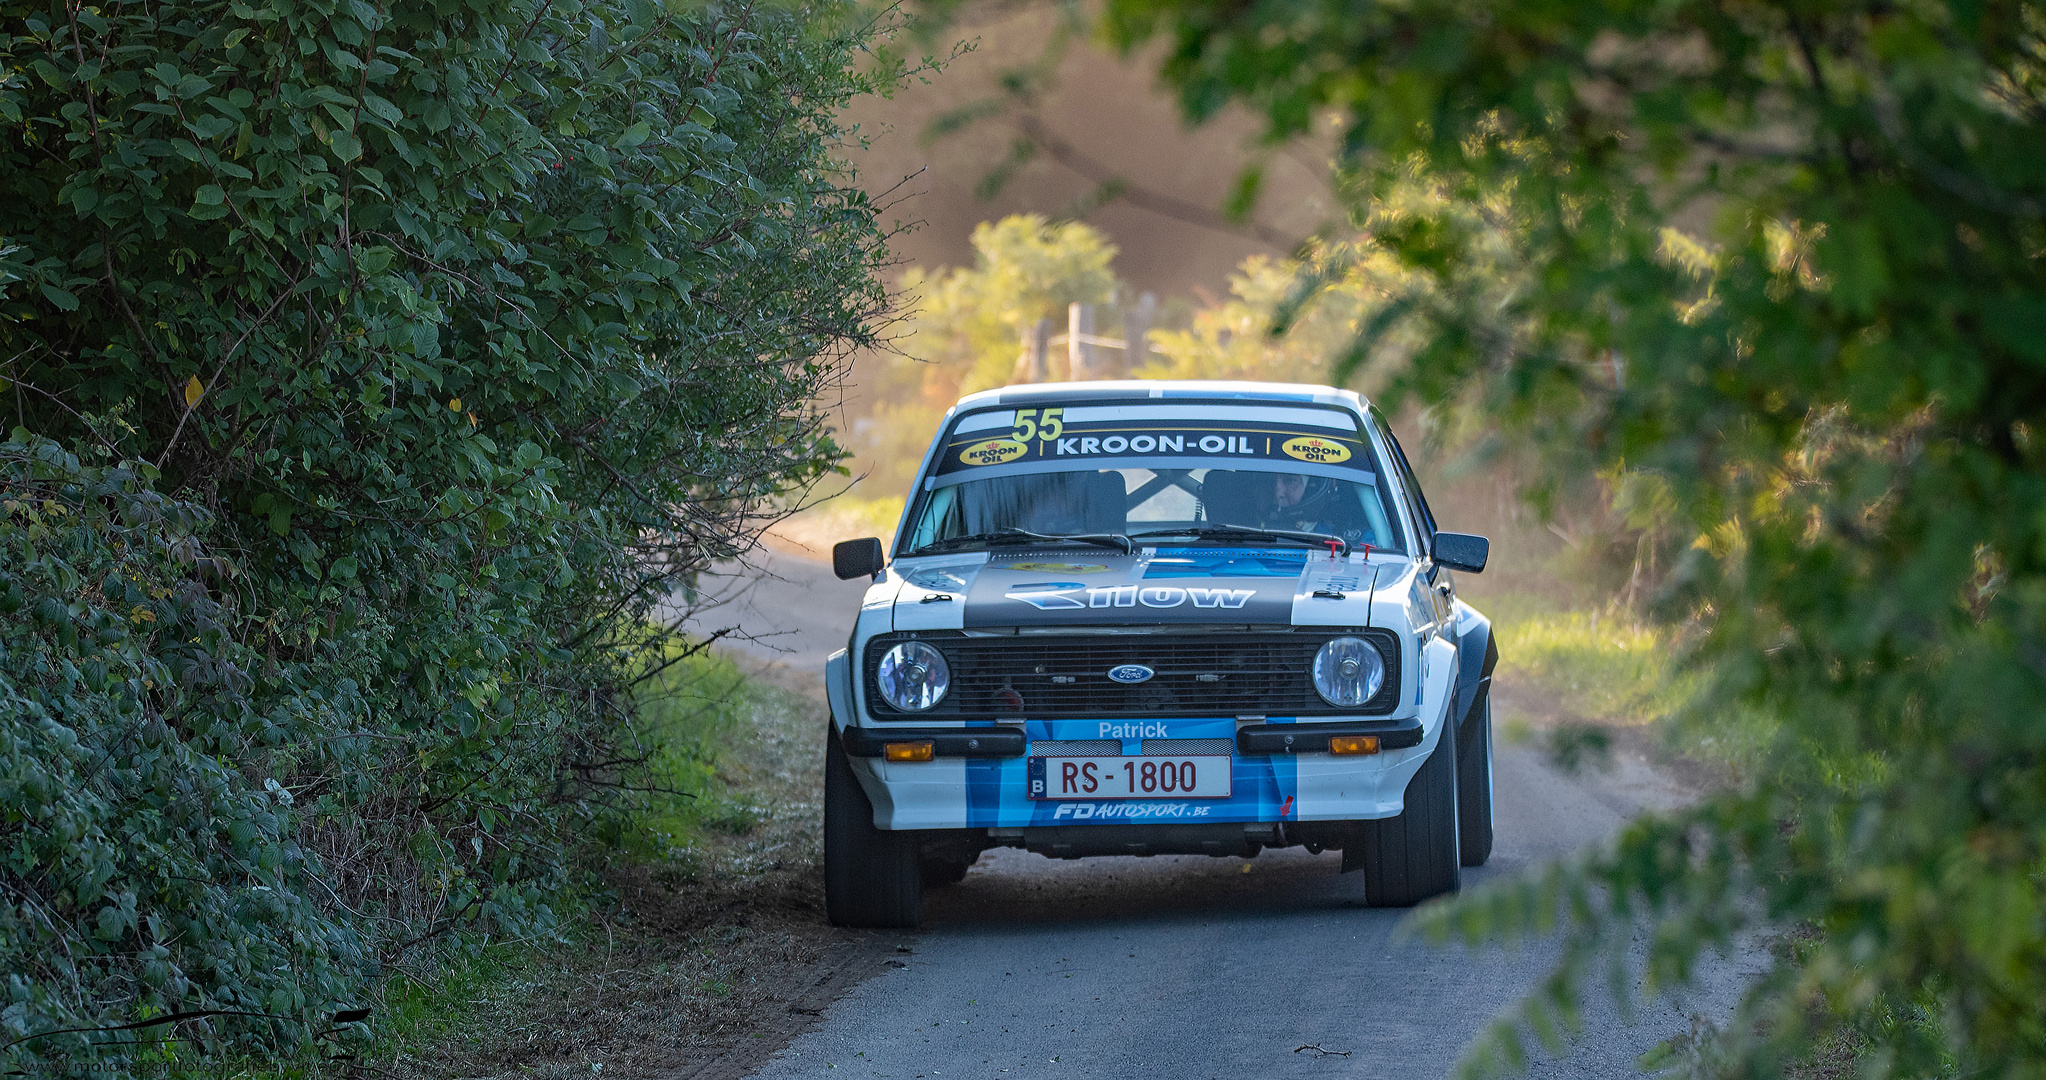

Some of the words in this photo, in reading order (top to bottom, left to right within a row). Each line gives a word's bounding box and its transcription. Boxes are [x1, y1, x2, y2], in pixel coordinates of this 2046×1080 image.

[1012, 408, 1063, 442] 55
[1056, 436, 1254, 455] KROON-OIL
[1292, 444, 1341, 456] KROON
[969, 447, 1018, 459] KROON
[1304, 453, 1327, 461] OIL
[981, 456, 1003, 464] OIL
[1119, 668, 1143, 679] Ford
[1099, 721, 1168, 738] Patrick
[1062, 761, 1197, 793] RS-1800
[1032, 780, 1044, 793] B
